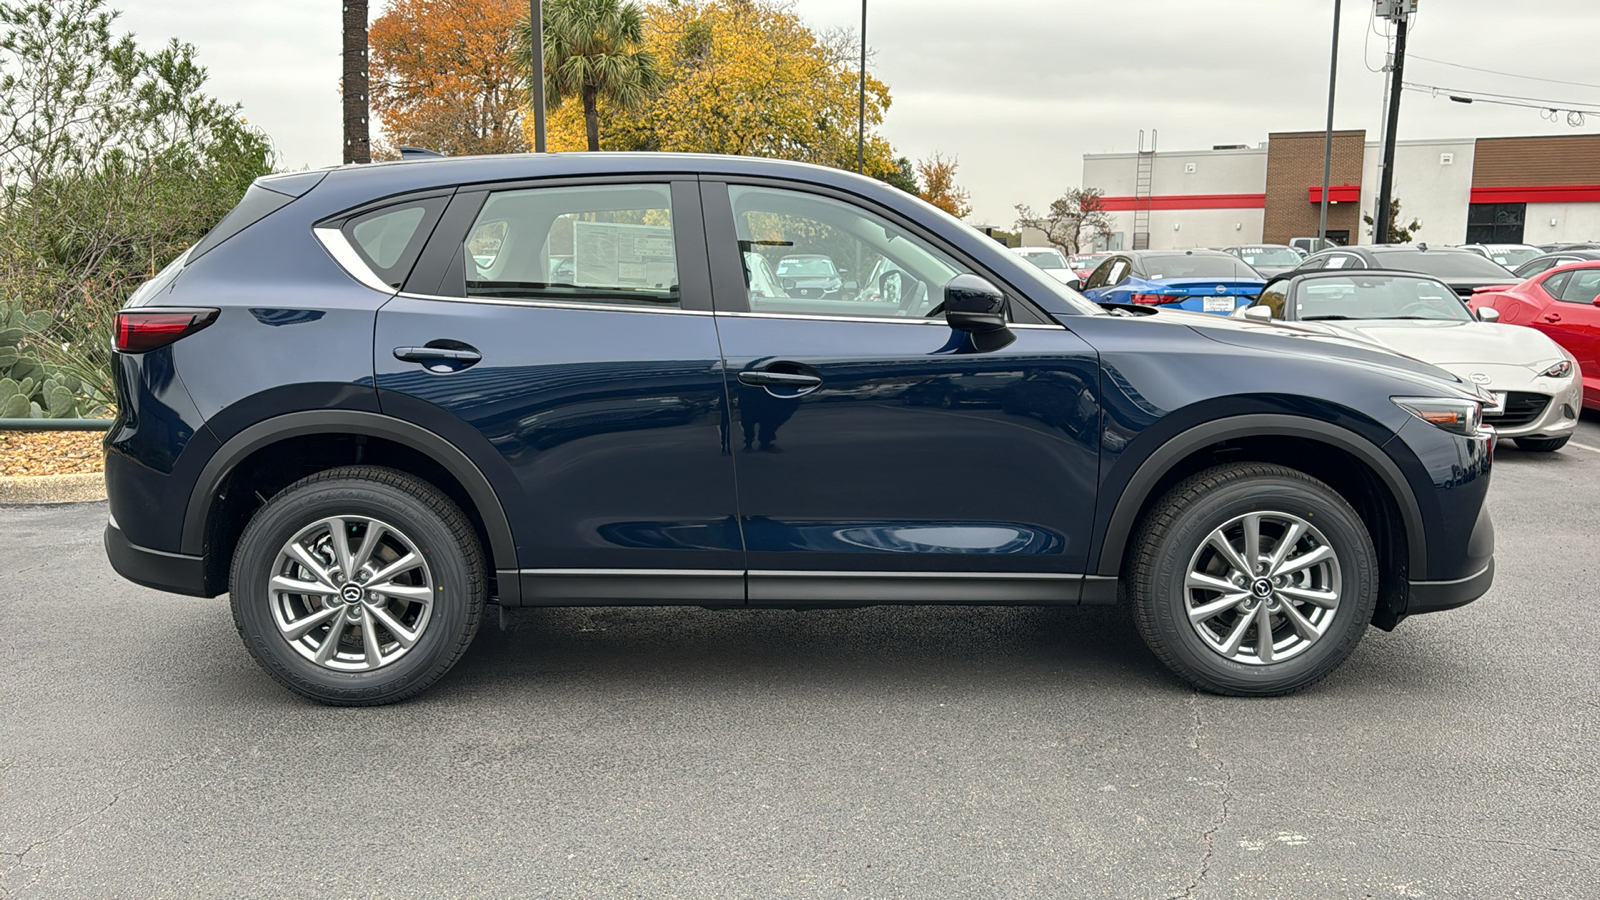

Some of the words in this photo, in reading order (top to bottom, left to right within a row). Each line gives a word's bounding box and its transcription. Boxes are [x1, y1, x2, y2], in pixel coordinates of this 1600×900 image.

[299, 488, 420, 522] YOKOHAMA
[1158, 513, 1200, 644] GEOLANDAR
[1337, 540, 1370, 652] YOKOHAMA
[273, 660, 410, 699] GEOLANDAR
